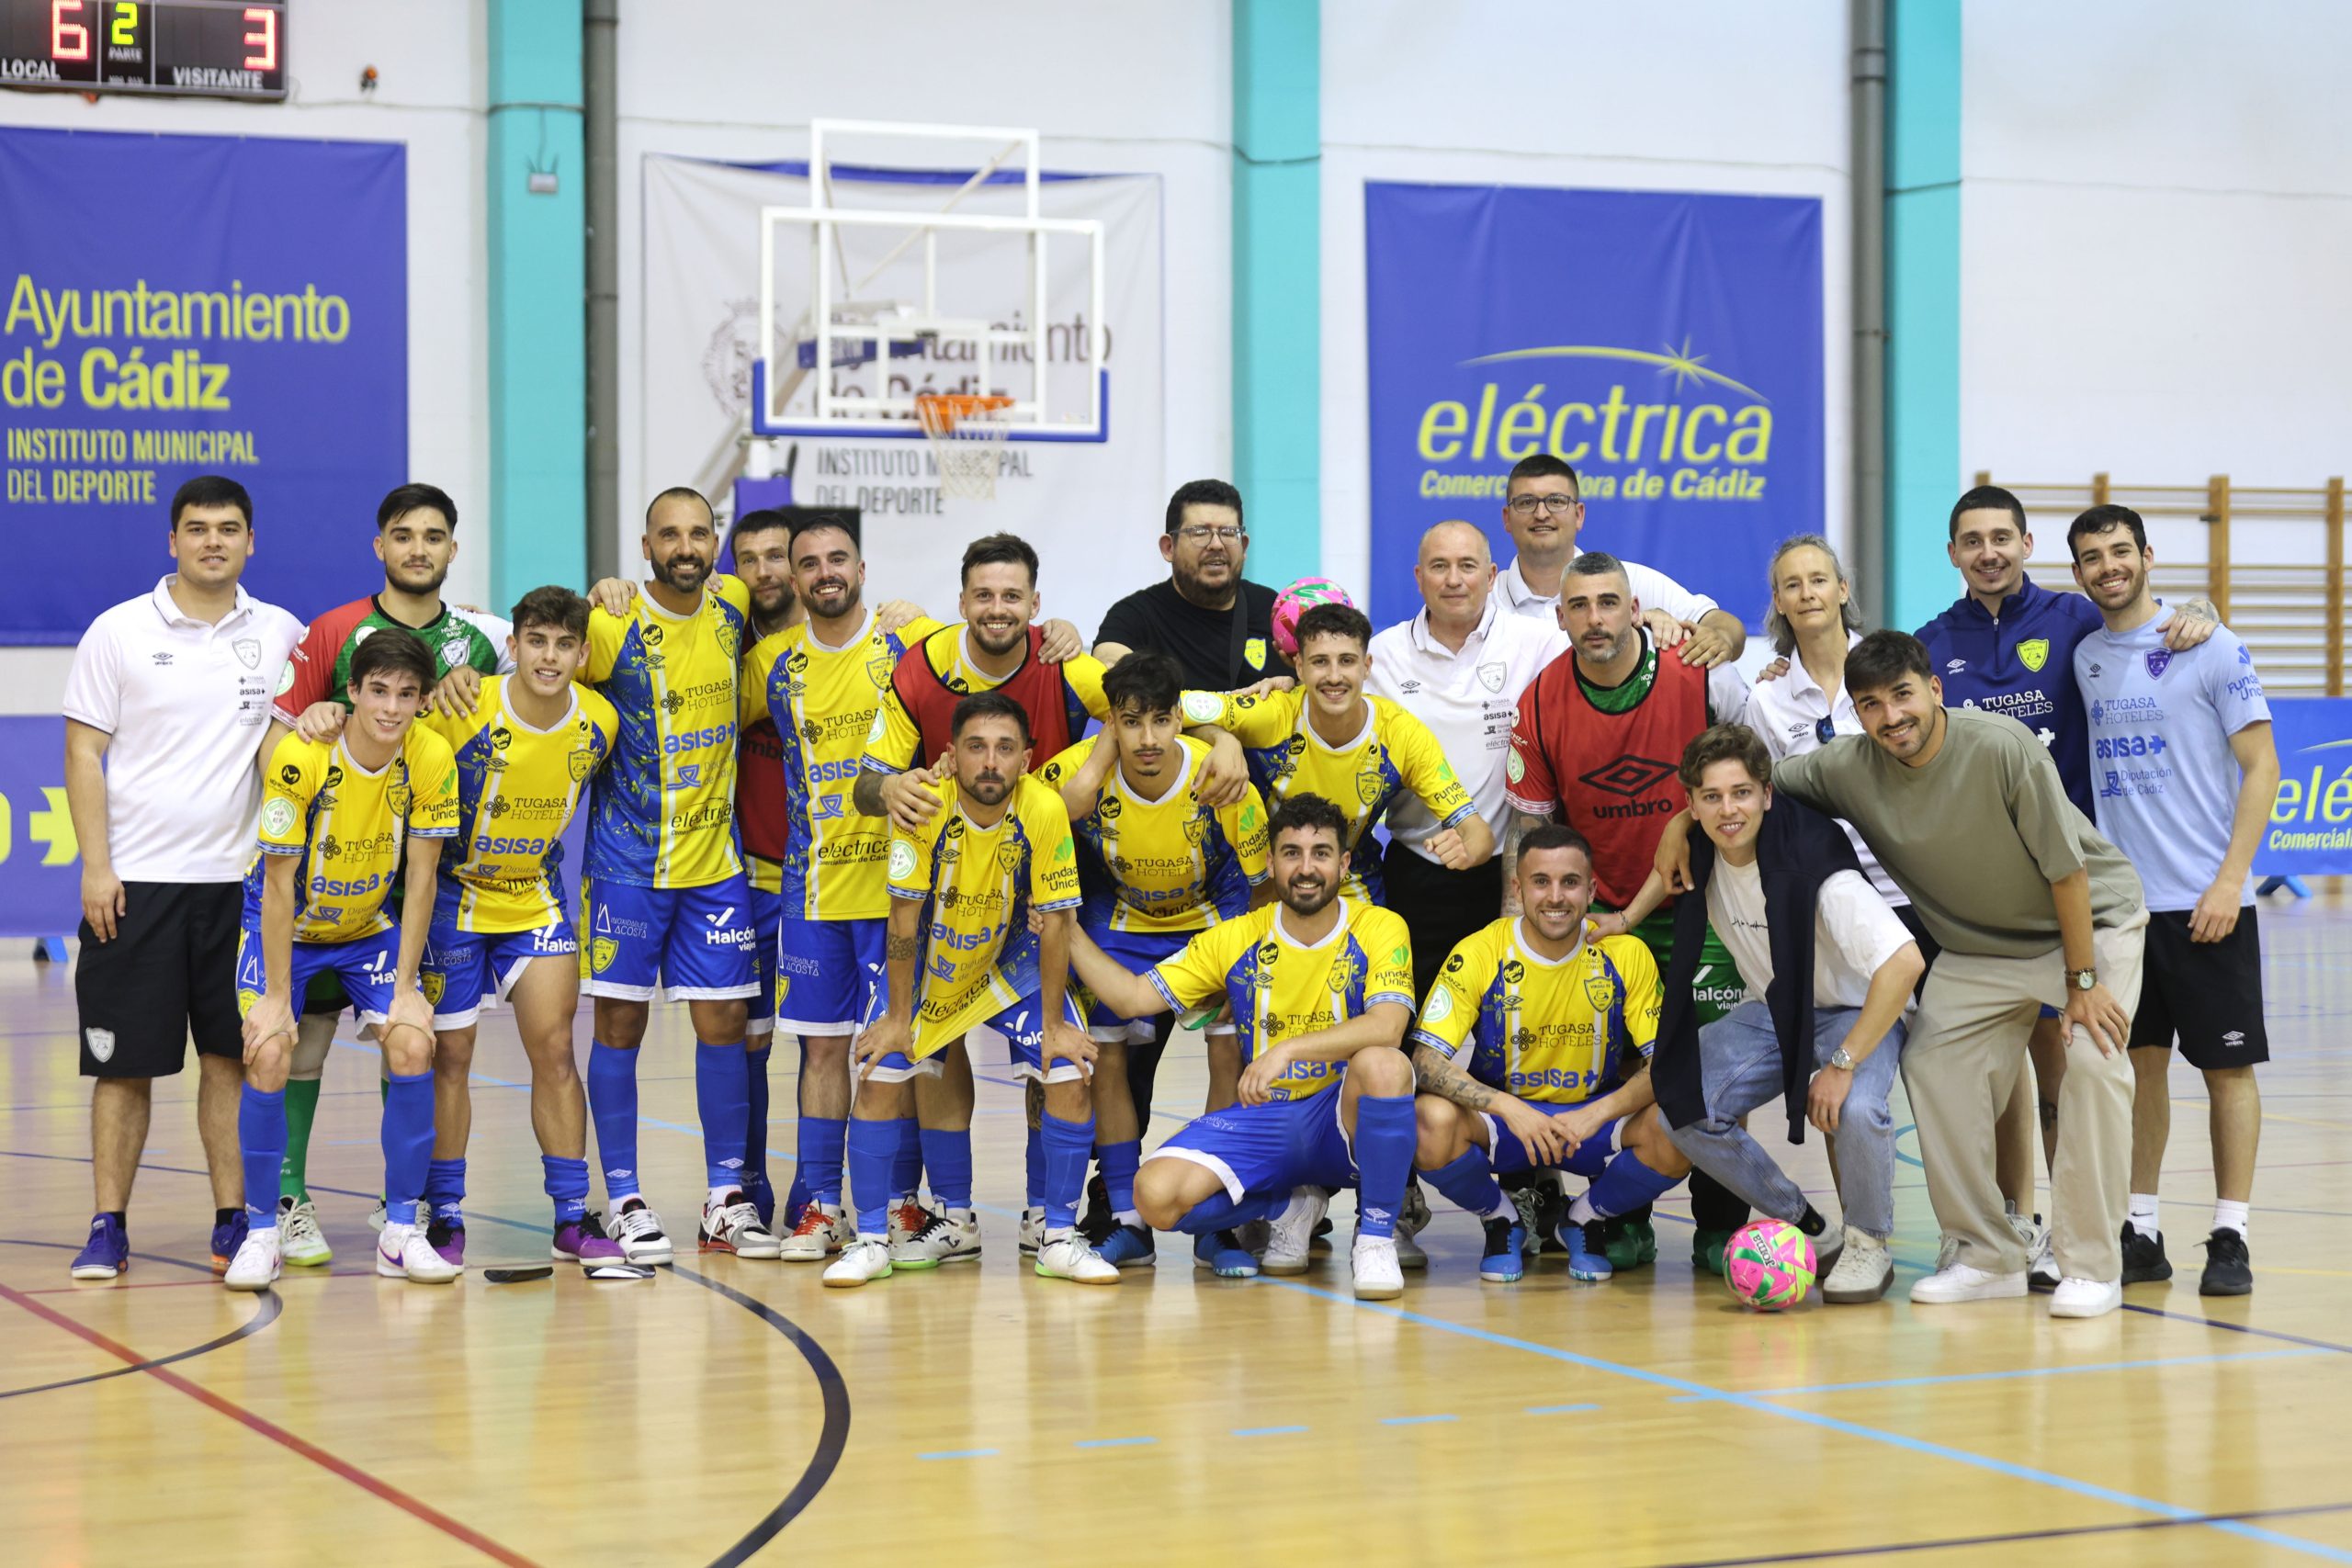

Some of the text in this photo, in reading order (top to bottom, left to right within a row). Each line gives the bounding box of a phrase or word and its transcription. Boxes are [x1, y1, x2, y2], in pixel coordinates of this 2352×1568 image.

[51, 0, 88, 60] 6
[111, 2, 138, 45] 2
[243, 7, 276, 70] 3
[107, 47, 143, 62] PARTE
[2, 58, 61, 80] LOCAL
[173, 66, 264, 88] VISITANTE
[4, 274, 351, 349] Ayuntamiento
[2, 345, 232, 411] de Cádiz
[1417, 383, 1774, 463] eléctrica
[6, 428, 260, 465] INSTITUTO MUNICIPAL
[817, 448, 919, 477] INSTITUTO
[7, 468, 157, 504] DEL DEPORTE
[1622, 469, 1665, 499] de
[1670, 467, 1767, 501] Cádiz
[816, 485, 944, 516] DEL DEPORTE
[1948, 667, 1964, 675] umbro
[684, 678, 734, 697] TUGASA
[687, 689, 736, 712] HOTELES
[1983, 689, 2046, 709] TUGASA
[2104, 696, 2157, 711] TUGASA
[1484, 711, 1508, 721] asisa
[2105, 708, 2165, 726] HOTELES
[663, 725, 727, 754] asisa
[1792, 731, 1809, 740] umbro
[2096, 736, 2148, 760] asisa
[2120, 766, 2173, 782] Diputación
[2121, 783, 2164, 796] de Cádiz
[2268, 764, 2352, 824] elé
[423, 796, 459, 813] Fundac
[514, 797, 569, 809] TUGASA
[1592, 797, 1673, 819] umbro
[432, 807, 460, 822] Unica
[510, 808, 571, 821] HOTELES
[474, 835, 546, 855] asisa
[869, 853, 888, 863] Cádi
[1134, 855, 1194, 868] TUGASA
[311, 873, 379, 897] asisa
[1040, 866, 1080, 885] Fundac
[1049, 876, 1080, 892] Unica
[614, 925, 648, 939] ACOSTA
[706, 925, 756, 945] Halcón
[931, 920, 992, 952] asisa
[739, 940, 756, 953] viajes
[437, 953, 471, 966] ACOSTA
[786, 961, 820, 977] ACOSTA
[370, 969, 398, 986] Hal
[1716, 1002, 1739, 1011] viaje
[1538, 1022, 1596, 1036] TUGASA
[1539, 1034, 1602, 1049] HOTELES
[2224, 1039, 2245, 1047] umbro
[1510, 1069, 1579, 1089] asisa
[1753, 1234, 1776, 1267] Joma
